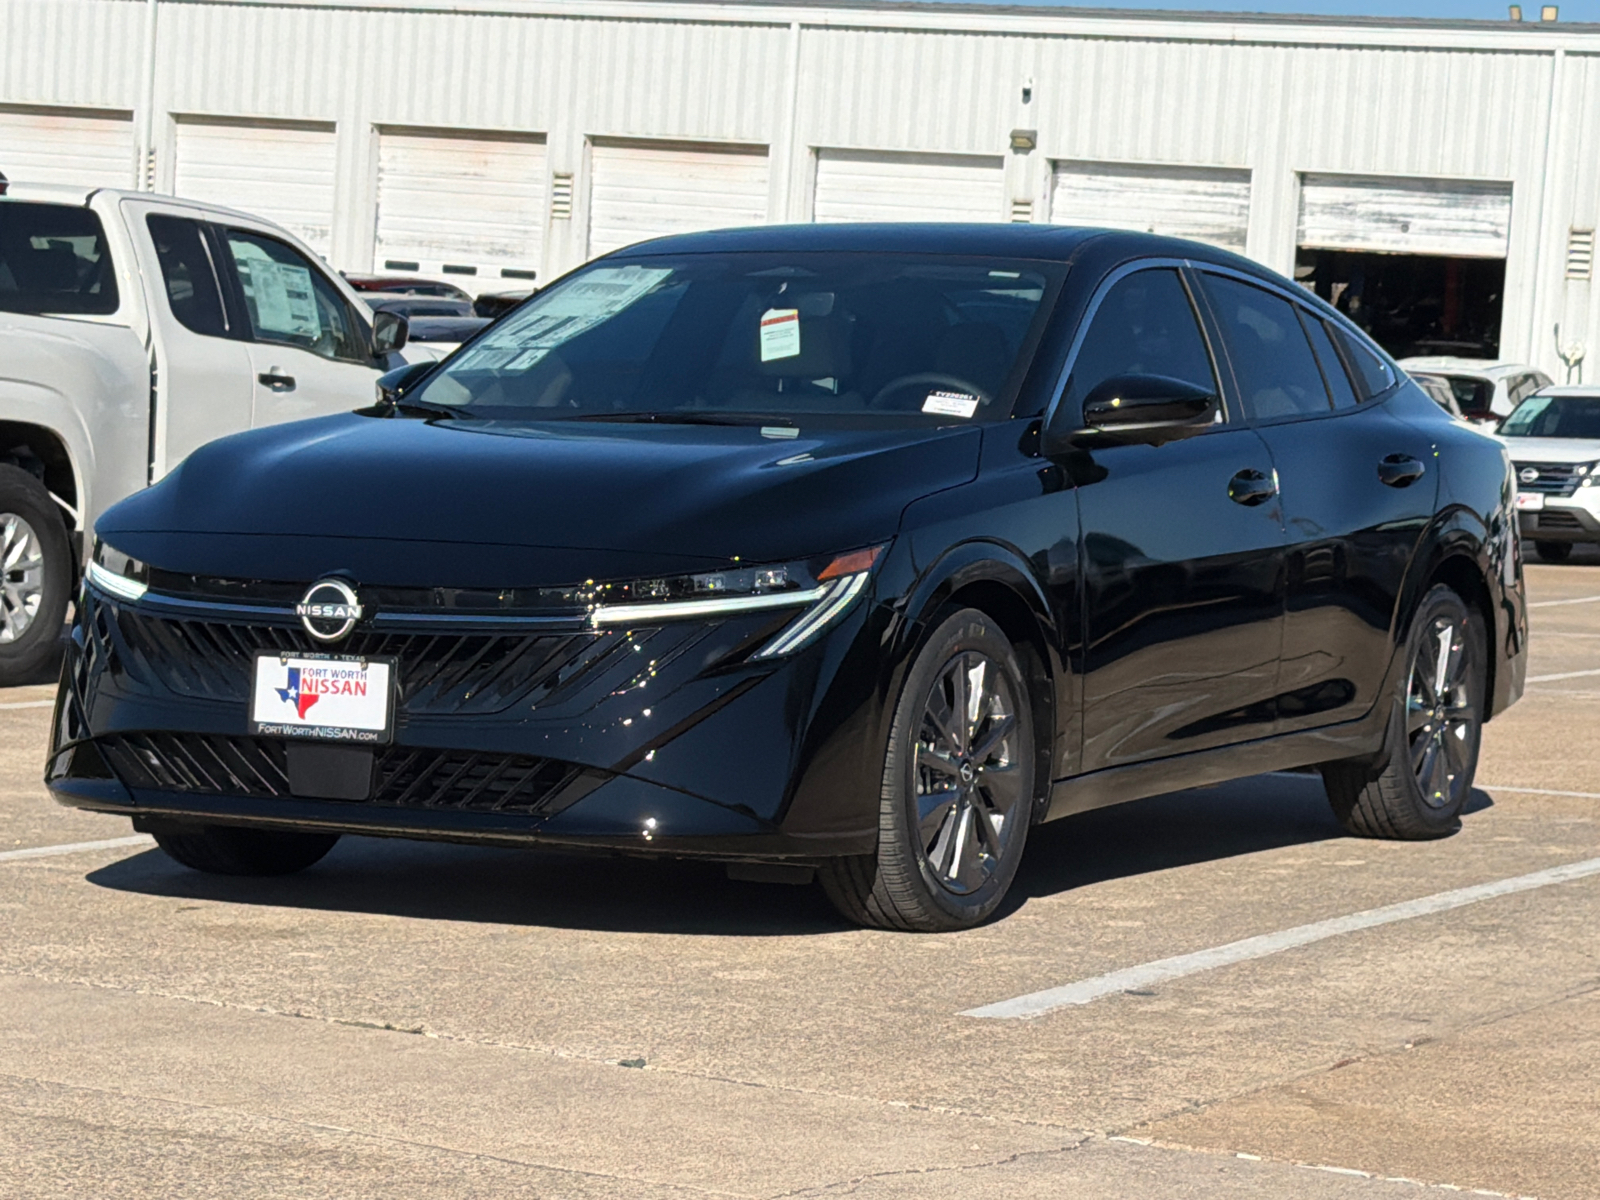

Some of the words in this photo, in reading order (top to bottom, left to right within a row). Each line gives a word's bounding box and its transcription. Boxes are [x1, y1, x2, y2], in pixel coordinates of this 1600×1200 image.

[297, 604, 359, 618] NISSAN
[303, 652, 330, 660] WORTH
[341, 654, 366, 662] TEXAS
[302, 667, 328, 678] FORT
[331, 669, 367, 680] WORTH
[301, 678, 367, 696] NISSAN
